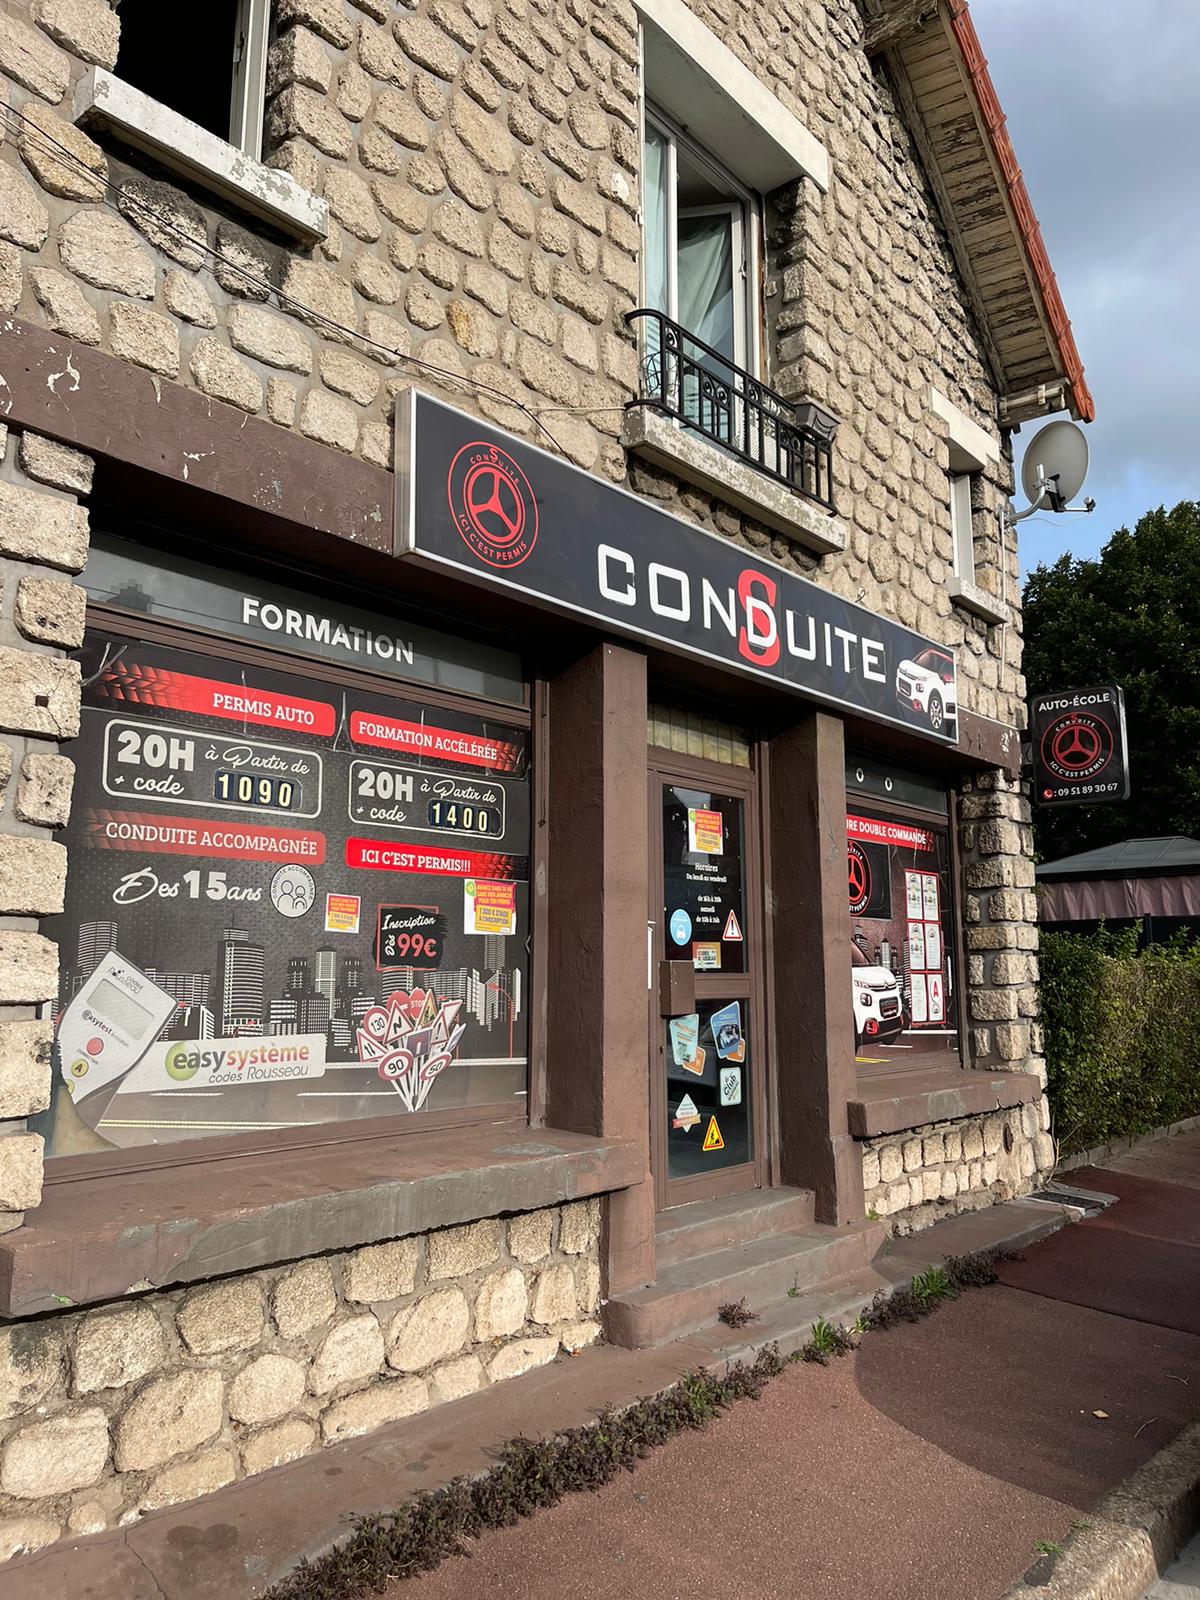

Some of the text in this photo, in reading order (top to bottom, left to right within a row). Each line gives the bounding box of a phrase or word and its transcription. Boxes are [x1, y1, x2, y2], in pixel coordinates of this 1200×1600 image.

[459, 514, 527, 561] ICI C'EST PERMIS
[597, 543, 887, 684] CONDUITE
[243, 597, 413, 665] FORMATION
[213, 692, 314, 725] PERMIS AUTO
[1038, 693, 1110, 712] AUTO-ÉCOLE
[117, 730, 310, 775] 20H à Partir de
[359, 721, 497, 760] FORMATION ACCÉLÉRÉE
[1050, 758, 1105, 778] ICI C'EST PERMIS
[133, 775, 184, 795] code
[218, 773, 293, 807] 1090
[358, 768, 497, 803] 20H à Partir de
[1058, 788, 1069, 796] 09
[1071, 787, 1081, 795] 51
[1082, 785, 1093, 794] 89
[1095, 784, 1106, 793] 30
[1107, 783, 1118, 791] 67
[370, 805, 407, 821] code
[432, 802, 489, 831] 1400
[106, 822, 318, 856] CONDUITE ACCOMPAGNÉE
[860, 821, 888, 837] DOUBLE
[887, 827, 927, 845] COMMANDE
[361, 848, 471, 873] ICI C'EST PERMIS!!!
[183, 870, 228, 900] 15
[227, 886, 263, 901] ans
[272, 868, 287, 899] CONDUITE
[381, 913, 437, 930] Inscription
[397, 933, 438, 957] 99€
[933, 981, 939, 998] A
[371, 1017, 386, 1032] 130
[75, 1063, 83, 1073] A
[208, 1064, 310, 1083] codes Rousseau
[388, 1059, 404, 1074] 90
[428, 1061, 443, 1075] 50
